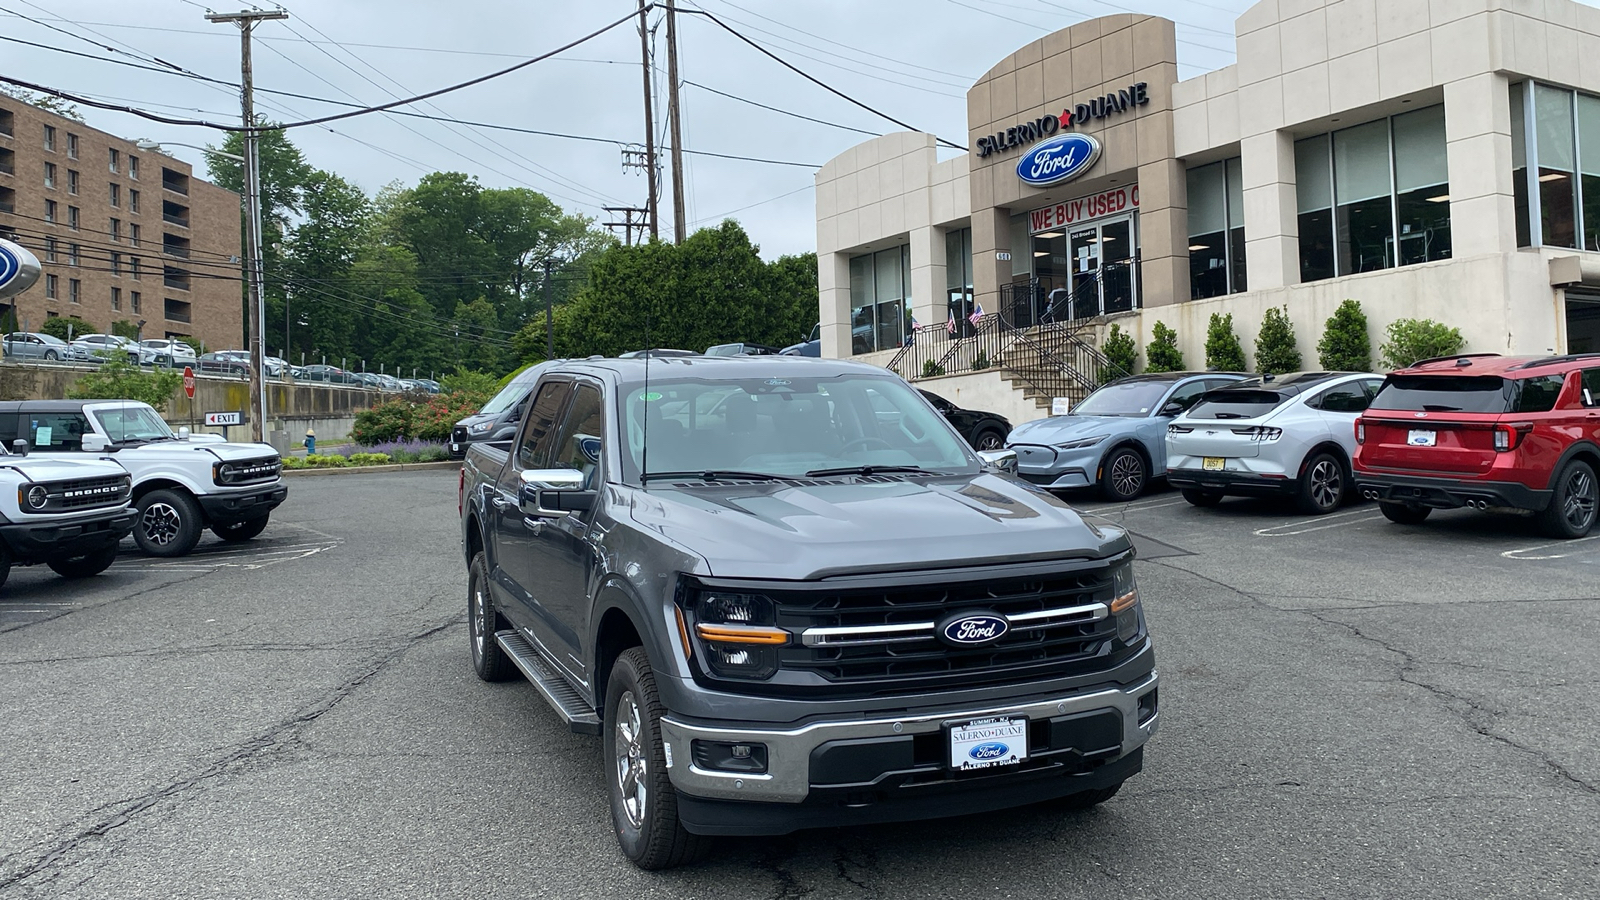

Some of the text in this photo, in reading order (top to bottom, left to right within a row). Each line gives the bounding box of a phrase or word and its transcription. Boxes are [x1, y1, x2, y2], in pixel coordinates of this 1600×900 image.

[976, 82, 1149, 158] SALERNO DUANE
[1030, 144, 1075, 178] Ford
[1031, 207, 1052, 231] WE
[1056, 199, 1083, 226] BUY
[1087, 189, 1126, 217] USED
[184, 376, 195, 389] STOP
[217, 414, 236, 423] EXIT
[243, 465, 276, 473] BRONCO
[64, 486, 118, 497] BRONCO
[957, 619, 997, 639] Ford
[953, 725, 1024, 742] SALERNO DUANE
[976, 744, 1001, 757] Ford
[960, 757, 1021, 771] SALERNO DUANE
